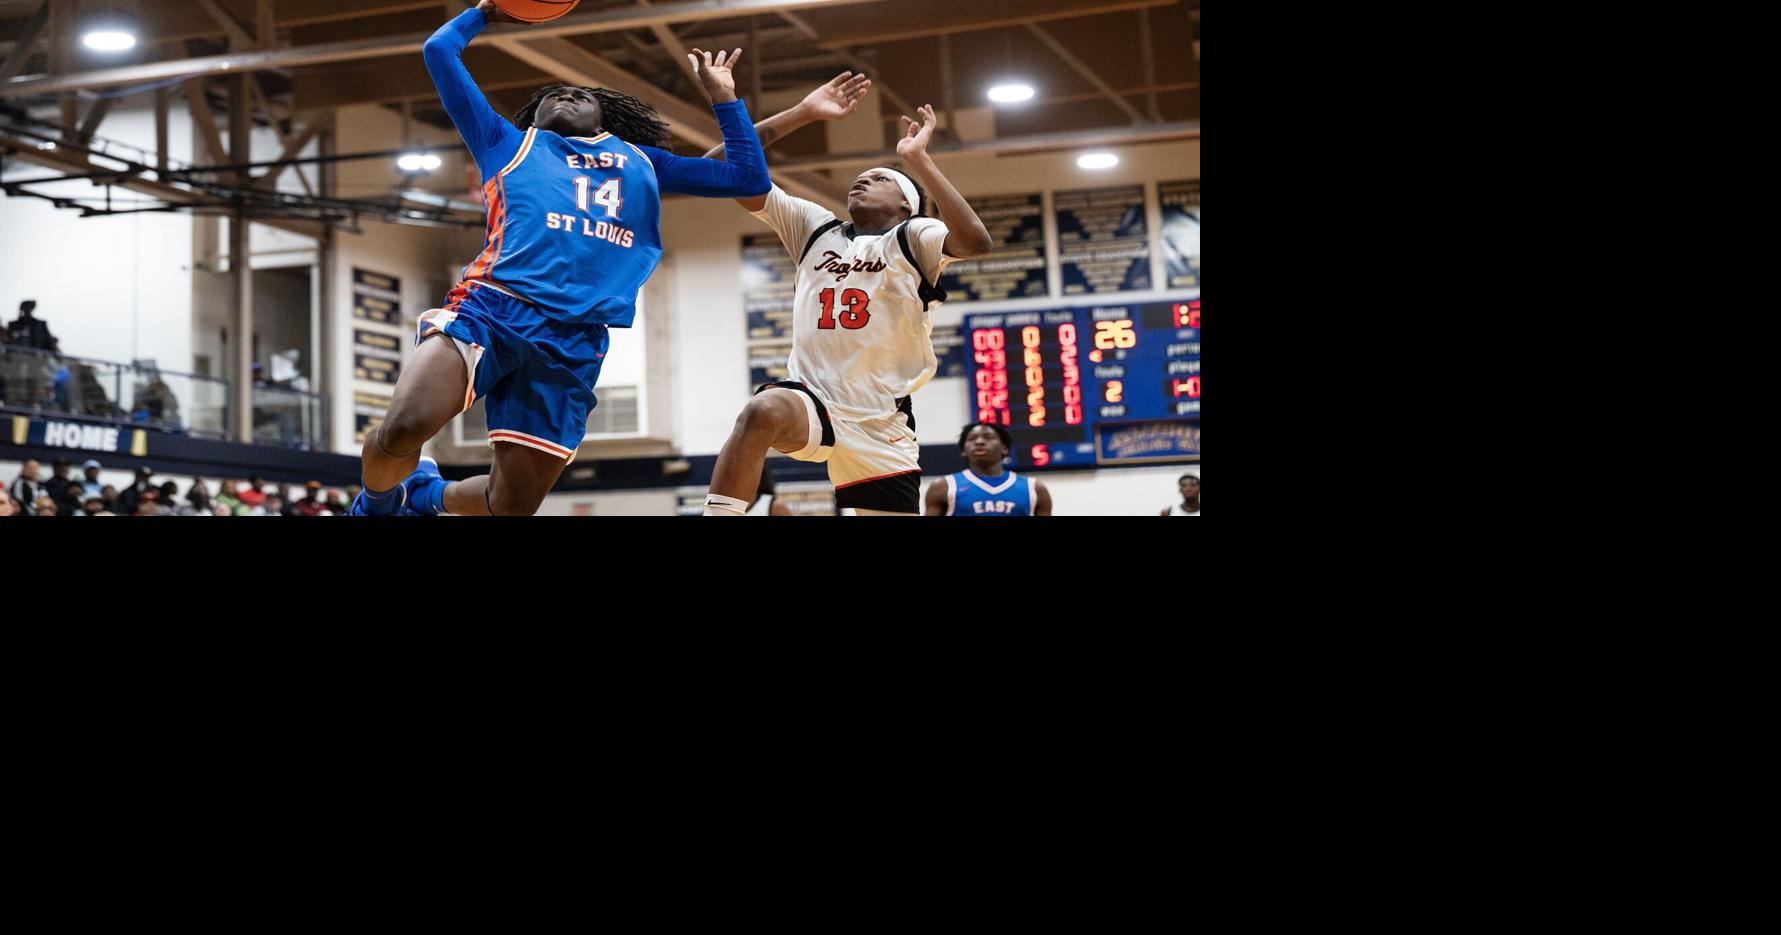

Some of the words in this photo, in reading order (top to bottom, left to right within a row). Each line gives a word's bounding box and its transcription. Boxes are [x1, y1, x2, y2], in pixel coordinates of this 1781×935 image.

[566, 152, 628, 169] EAST
[574, 175, 622, 219] 14
[546, 212, 576, 232] ST
[583, 218, 634, 248] LOUIS
[817, 288, 871, 330] 13
[1094, 319, 1136, 349] 26
[1105, 380, 1123, 402] 2
[44, 421, 119, 452] HOME
[972, 500, 1015, 515] EAST
